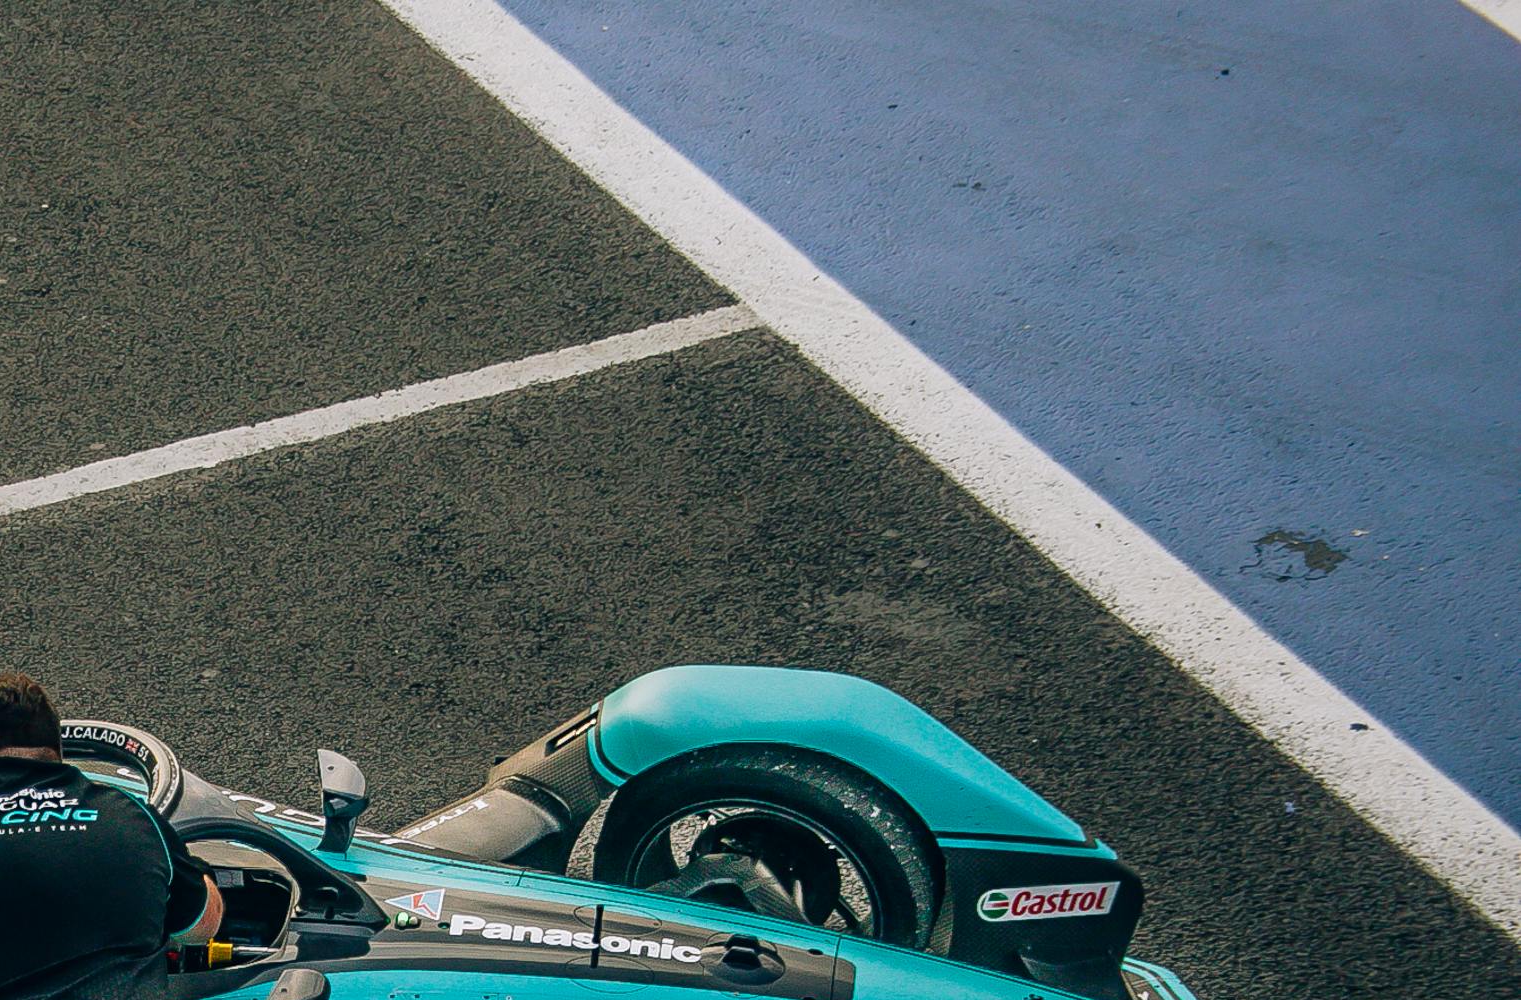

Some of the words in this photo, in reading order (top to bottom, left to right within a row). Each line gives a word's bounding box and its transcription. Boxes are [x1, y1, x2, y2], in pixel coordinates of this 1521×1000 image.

[61, 726, 126, 746] J.CALADO
[138, 746, 150, 762] 51
[1010, 885, 1110, 917] Castrol
[449, 915, 702, 963] Panasonic
